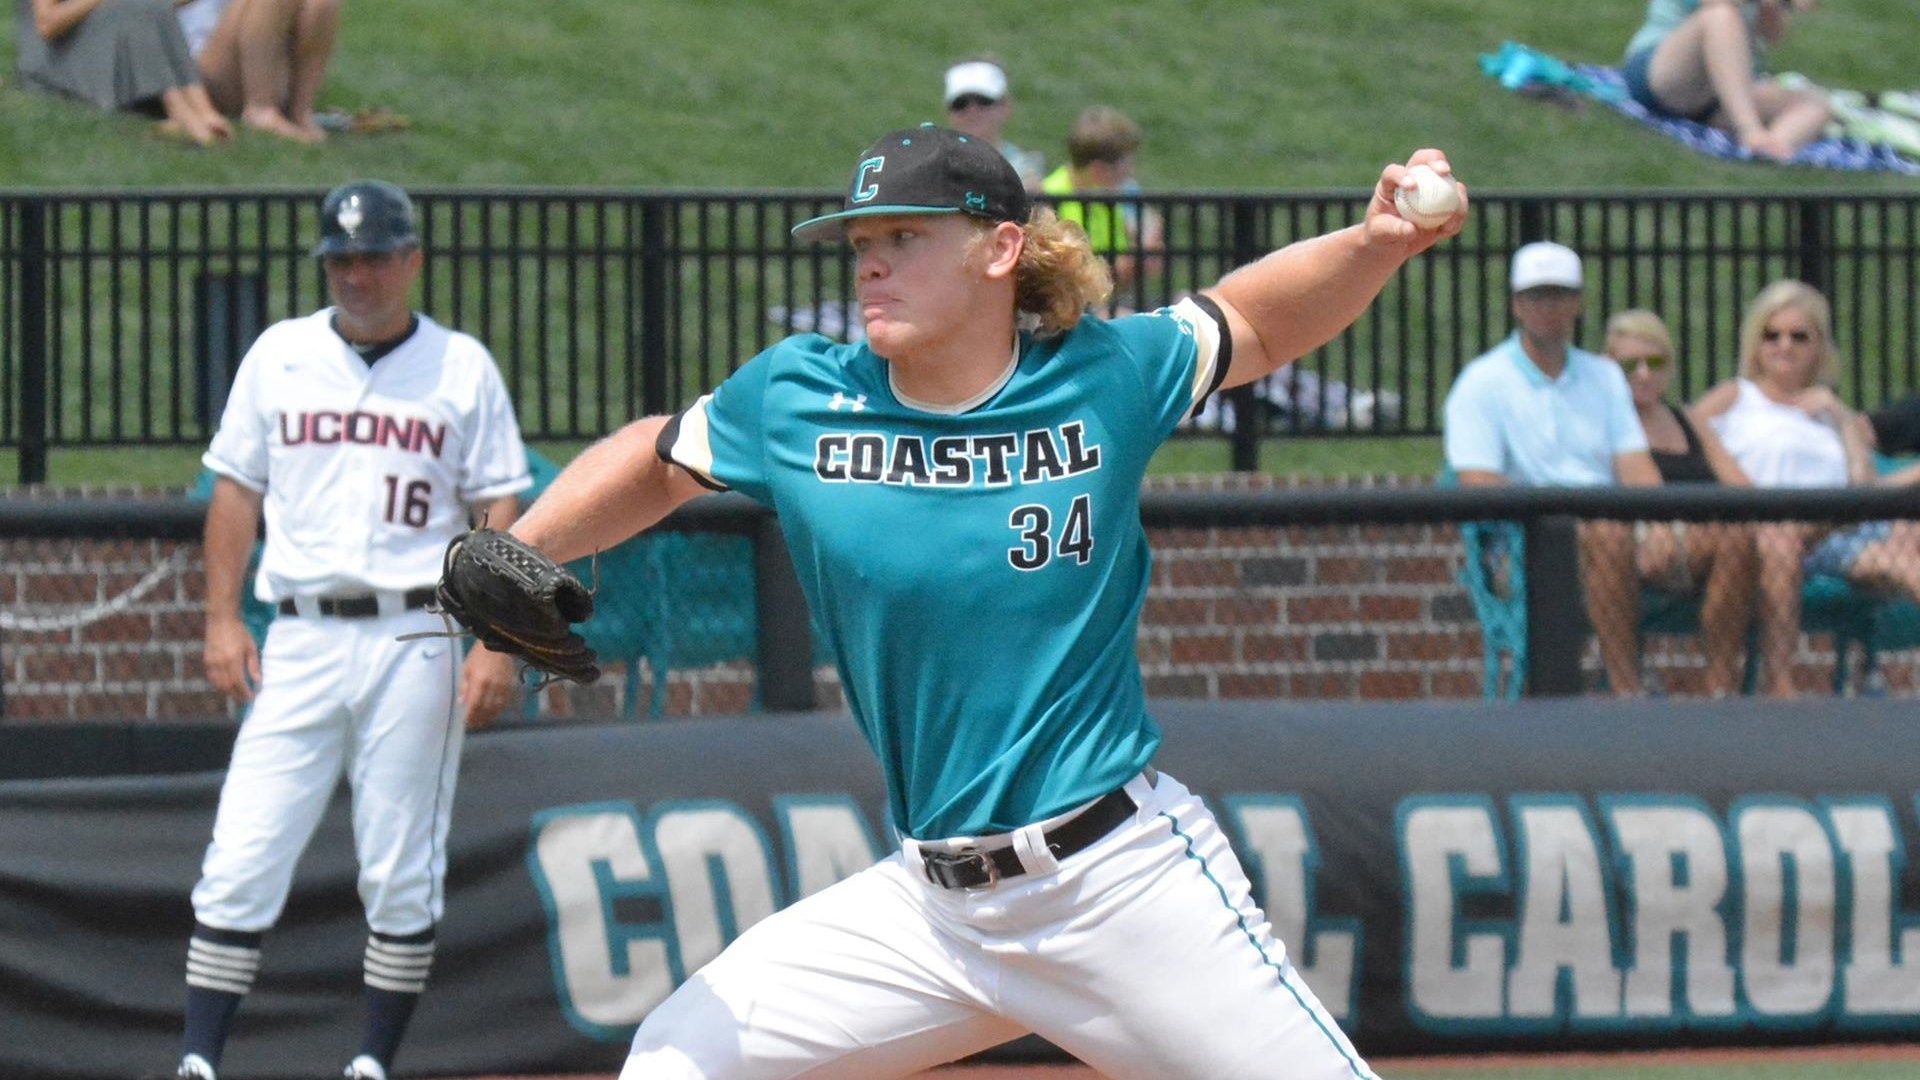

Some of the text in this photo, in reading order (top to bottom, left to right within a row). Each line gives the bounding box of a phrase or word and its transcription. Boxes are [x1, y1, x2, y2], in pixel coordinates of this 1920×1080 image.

[851, 156, 885, 203] C
[278, 410, 447, 459] UCONN
[813, 420, 1101, 488] COASTAL
[383, 473, 432, 529] 16
[1008, 493, 1094, 571] 34
[1396, 796, 1920, 1032] CAROL
